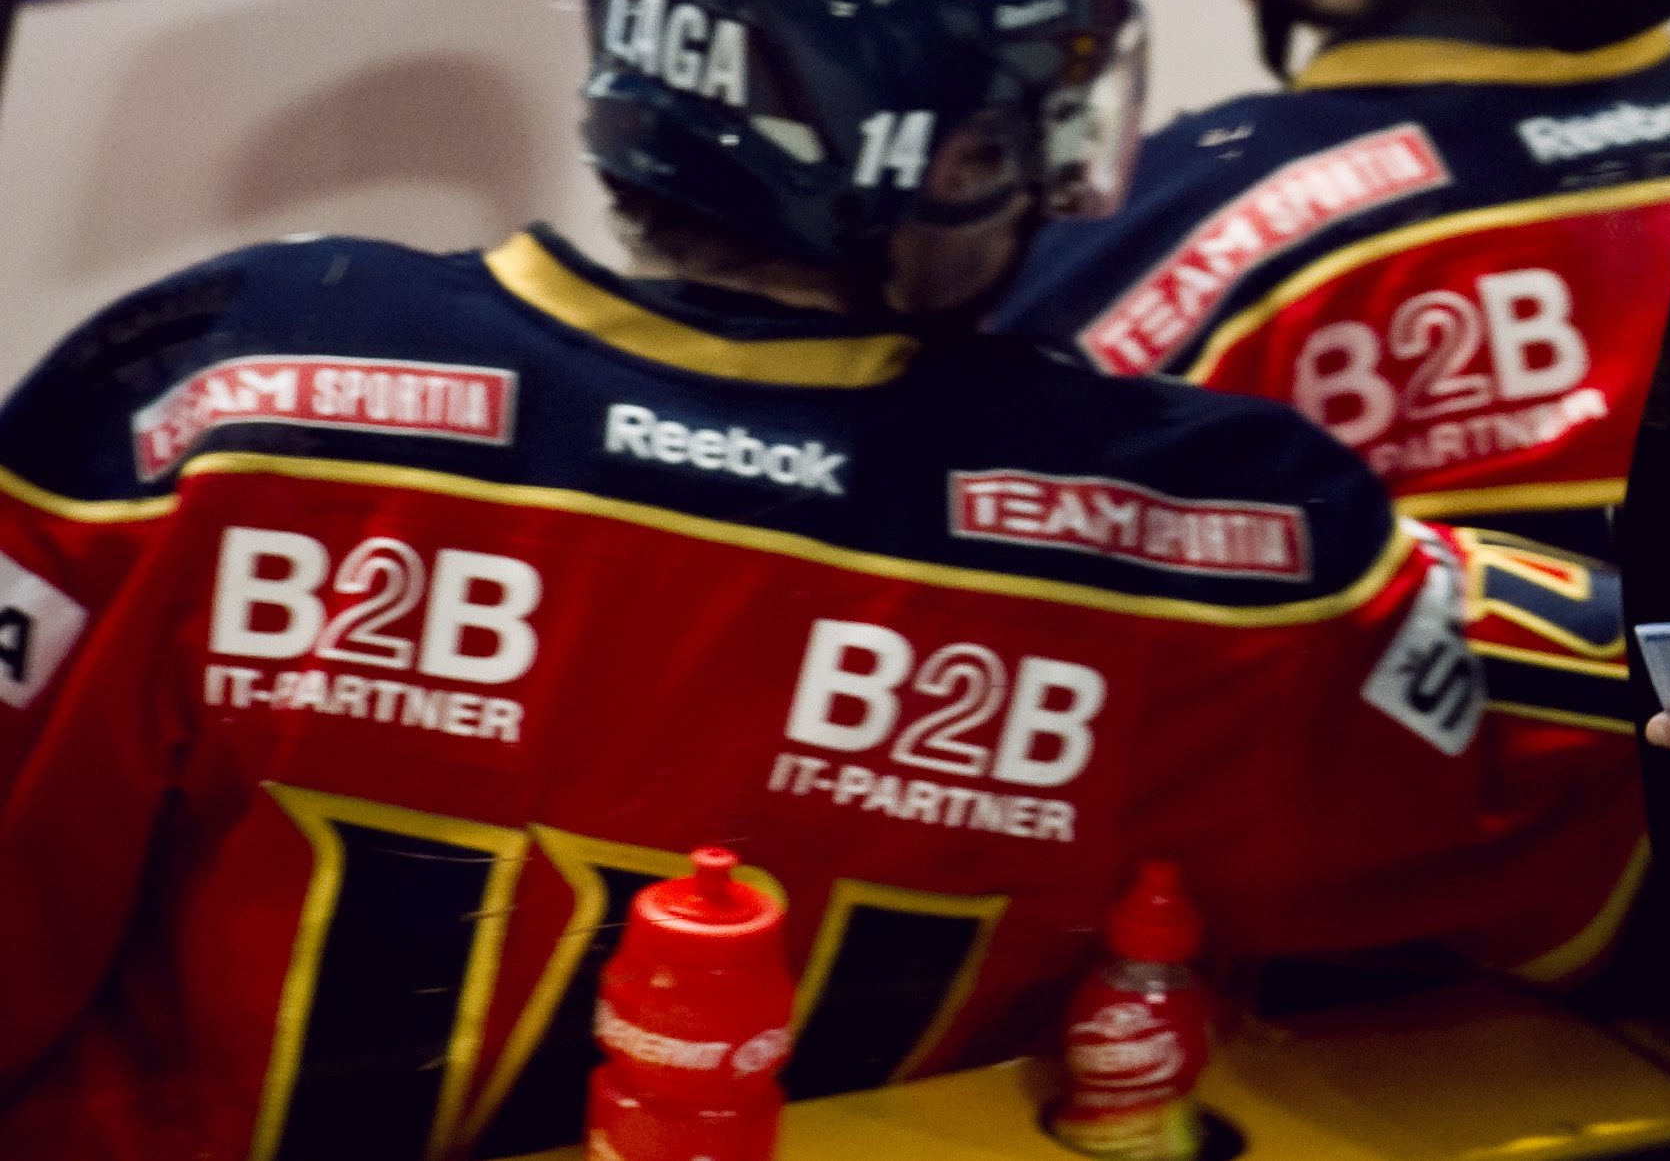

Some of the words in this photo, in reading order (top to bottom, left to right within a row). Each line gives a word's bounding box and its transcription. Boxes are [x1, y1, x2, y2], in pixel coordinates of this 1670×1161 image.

[855, 110, 935, 189] 14
[1101, 217, 1262, 365] TEAM
[1292, 269, 1590, 444] B2B
[605, 403, 848, 495] Reebok
[966, 482, 1140, 547] TEAM
[209, 526, 542, 685] B2B
[204, 664, 524, 741] IT-PARTNER
[785, 618, 1106, 787] B2B
[768, 752, 1076, 841] IT-PARTNER
